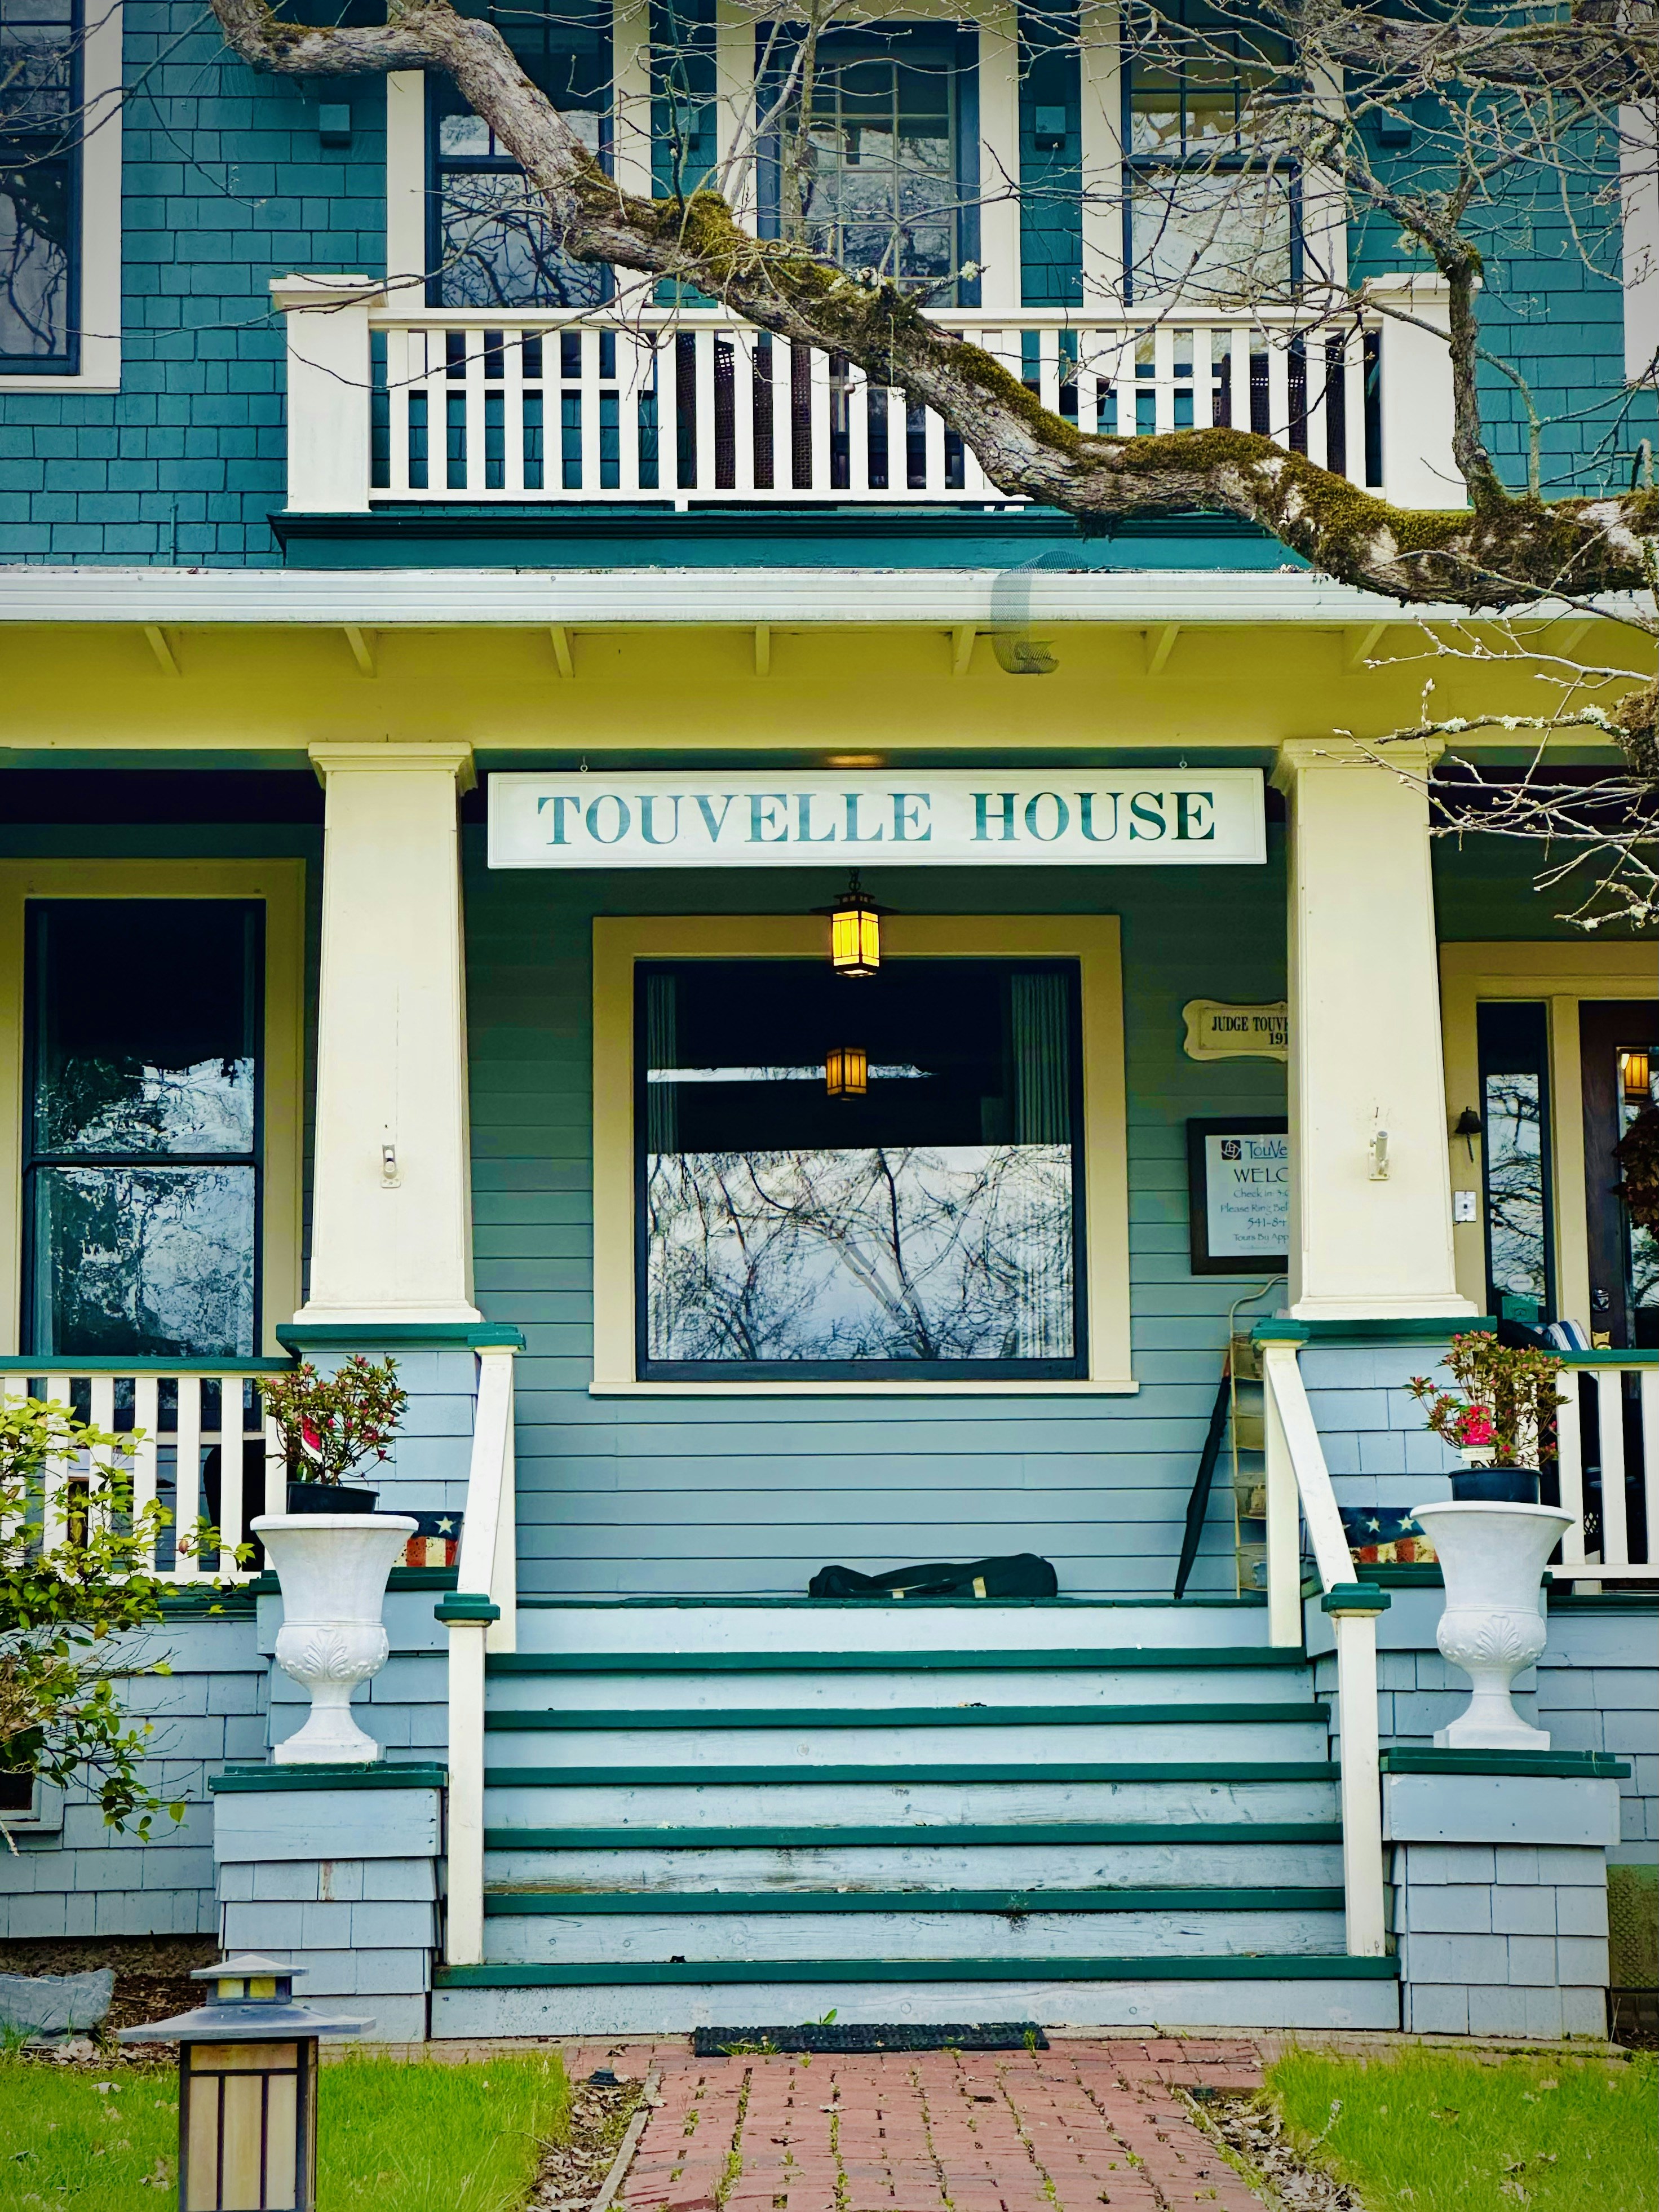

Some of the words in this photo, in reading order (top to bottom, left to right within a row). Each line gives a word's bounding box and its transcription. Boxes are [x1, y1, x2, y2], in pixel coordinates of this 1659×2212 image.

[537, 793, 931, 845] TOUVELLE
[969, 791, 1215, 842] HOUSE
[1211, 1016, 1249, 1032] JUDGE
[1233, 1188, 1262, 1198] Check
[1220, 1202, 1249, 1213] Please
[1251, 1204, 1272, 1215] Ring
[1257, 1233, 1269, 1244] By
